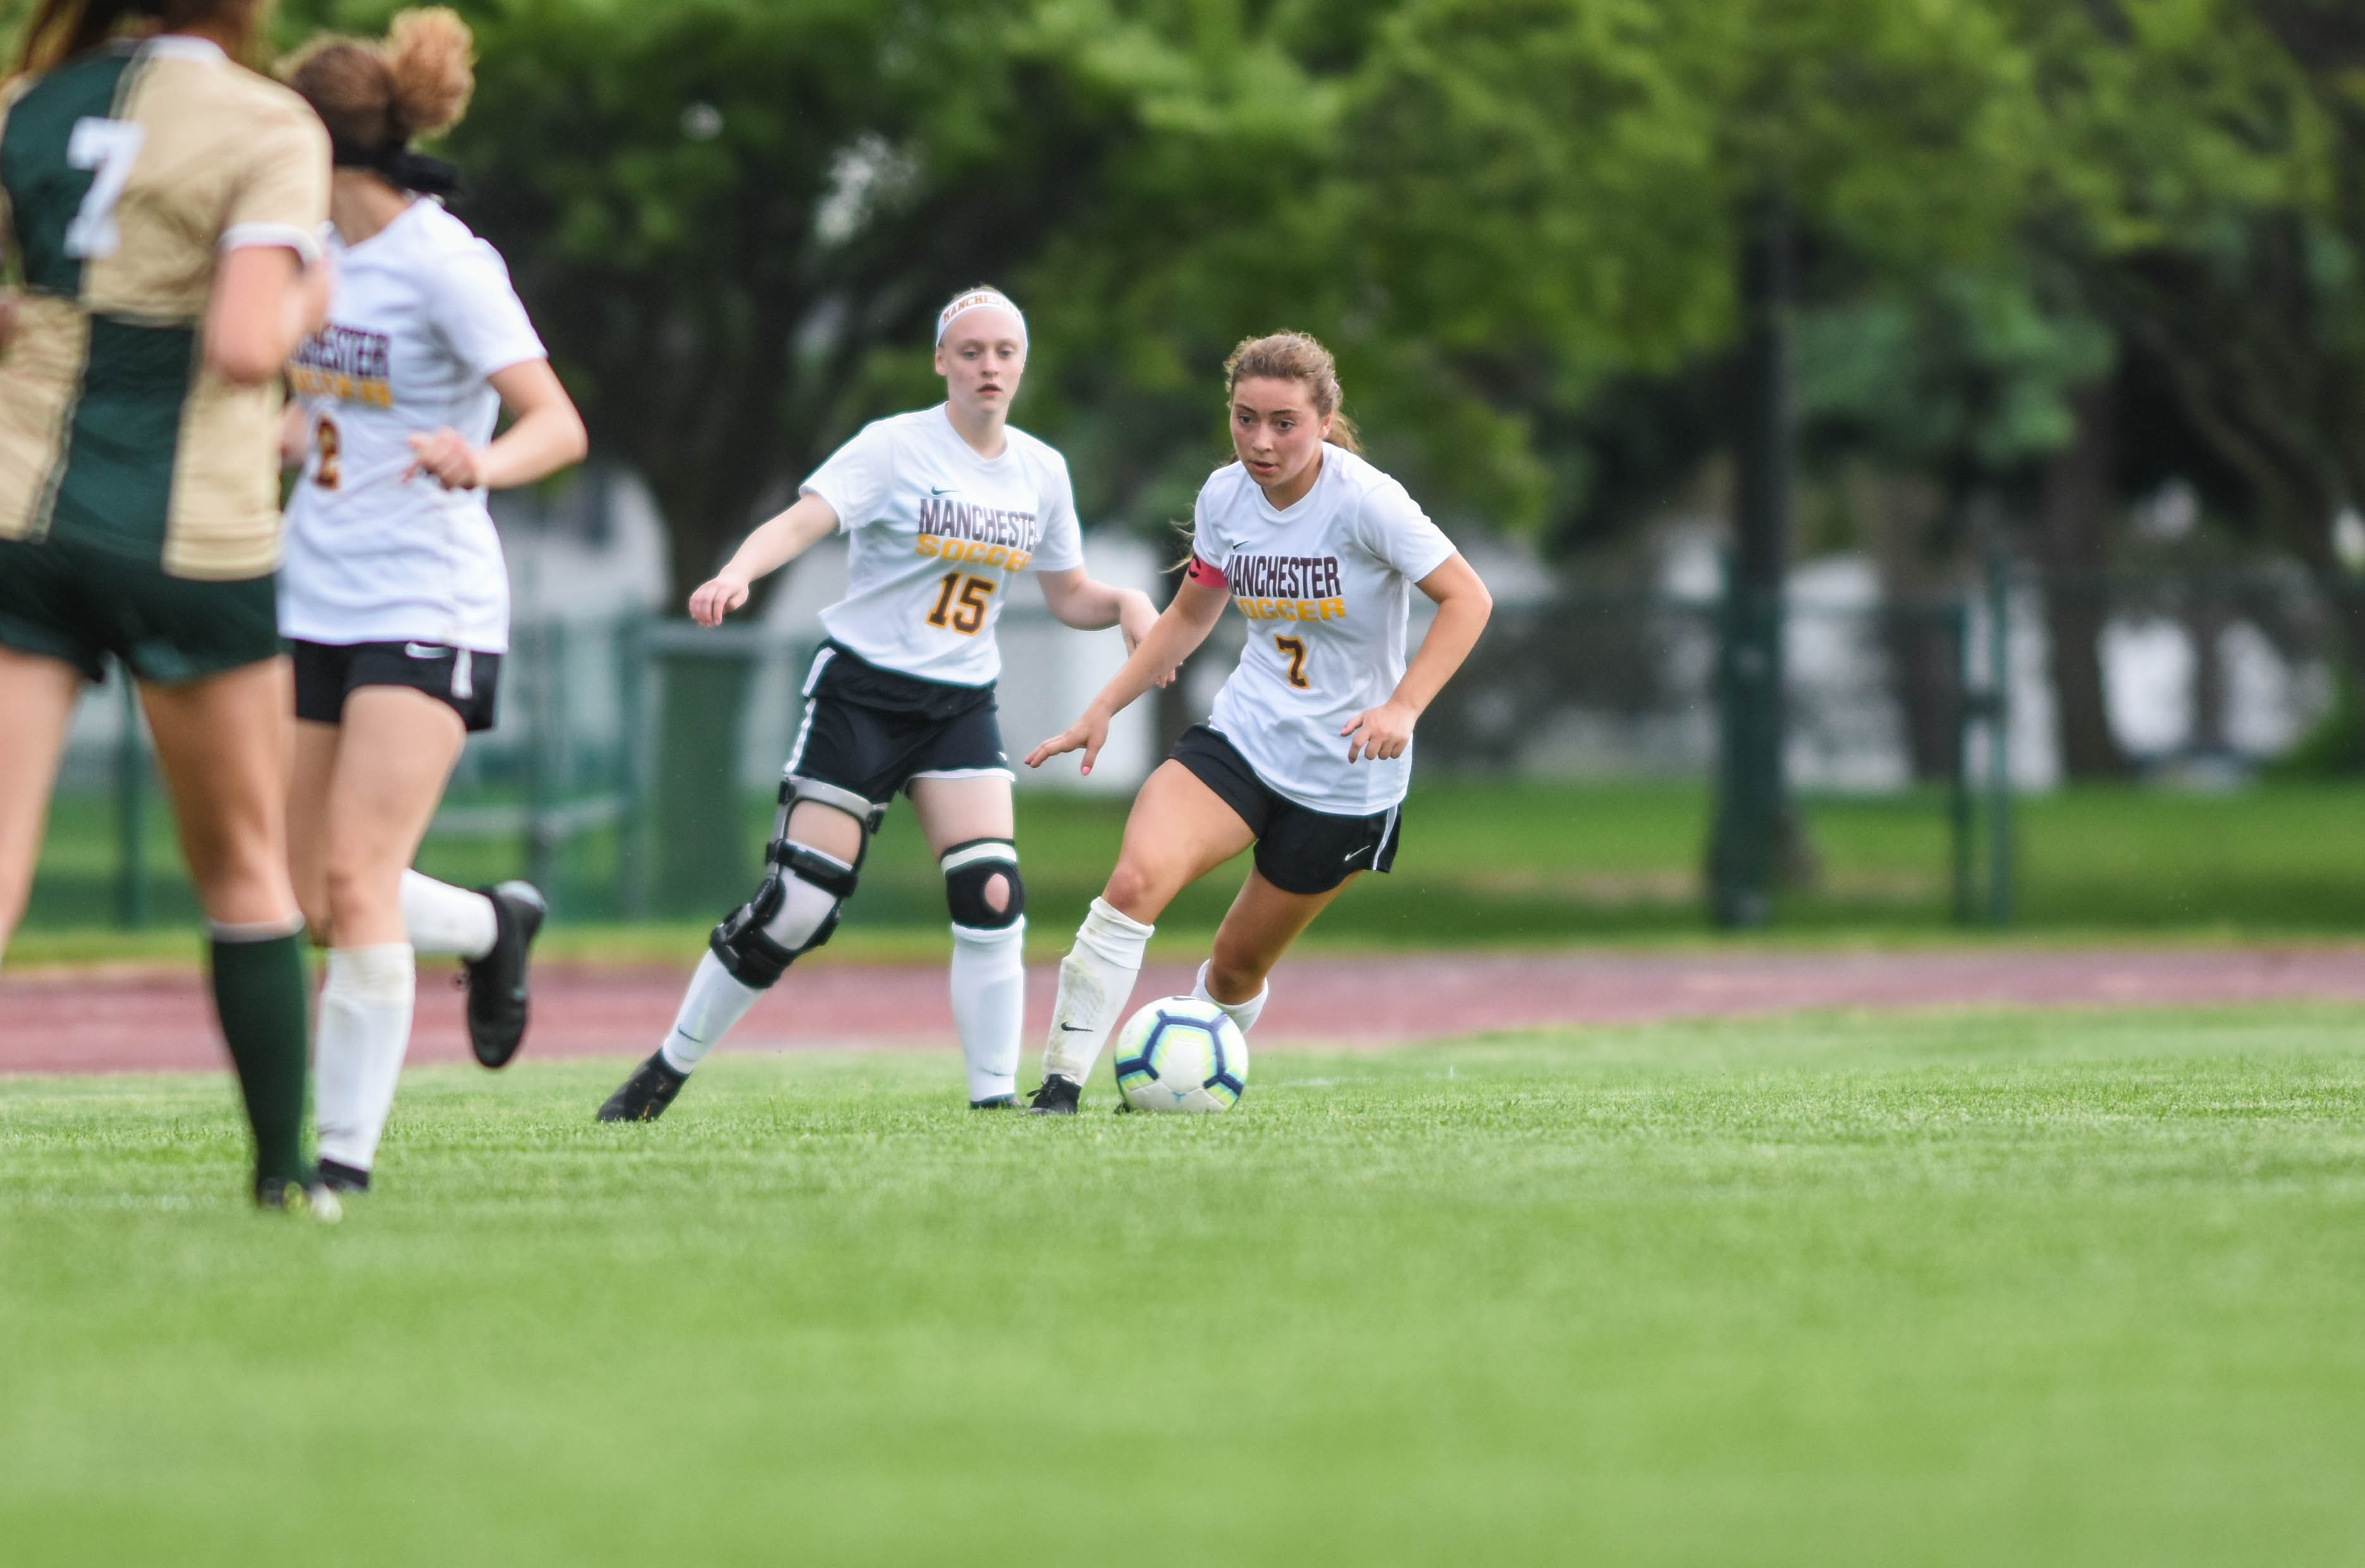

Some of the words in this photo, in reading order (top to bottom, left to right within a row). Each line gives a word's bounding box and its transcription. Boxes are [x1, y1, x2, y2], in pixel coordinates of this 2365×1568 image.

[66, 116, 147, 259] 7
[314, 415, 341, 491] 2
[918, 498, 1037, 554] MANCHESTE
[926, 570, 997, 637] 15
[1241, 597, 1346, 622] OCCER
[1274, 634, 1310, 690] 7
